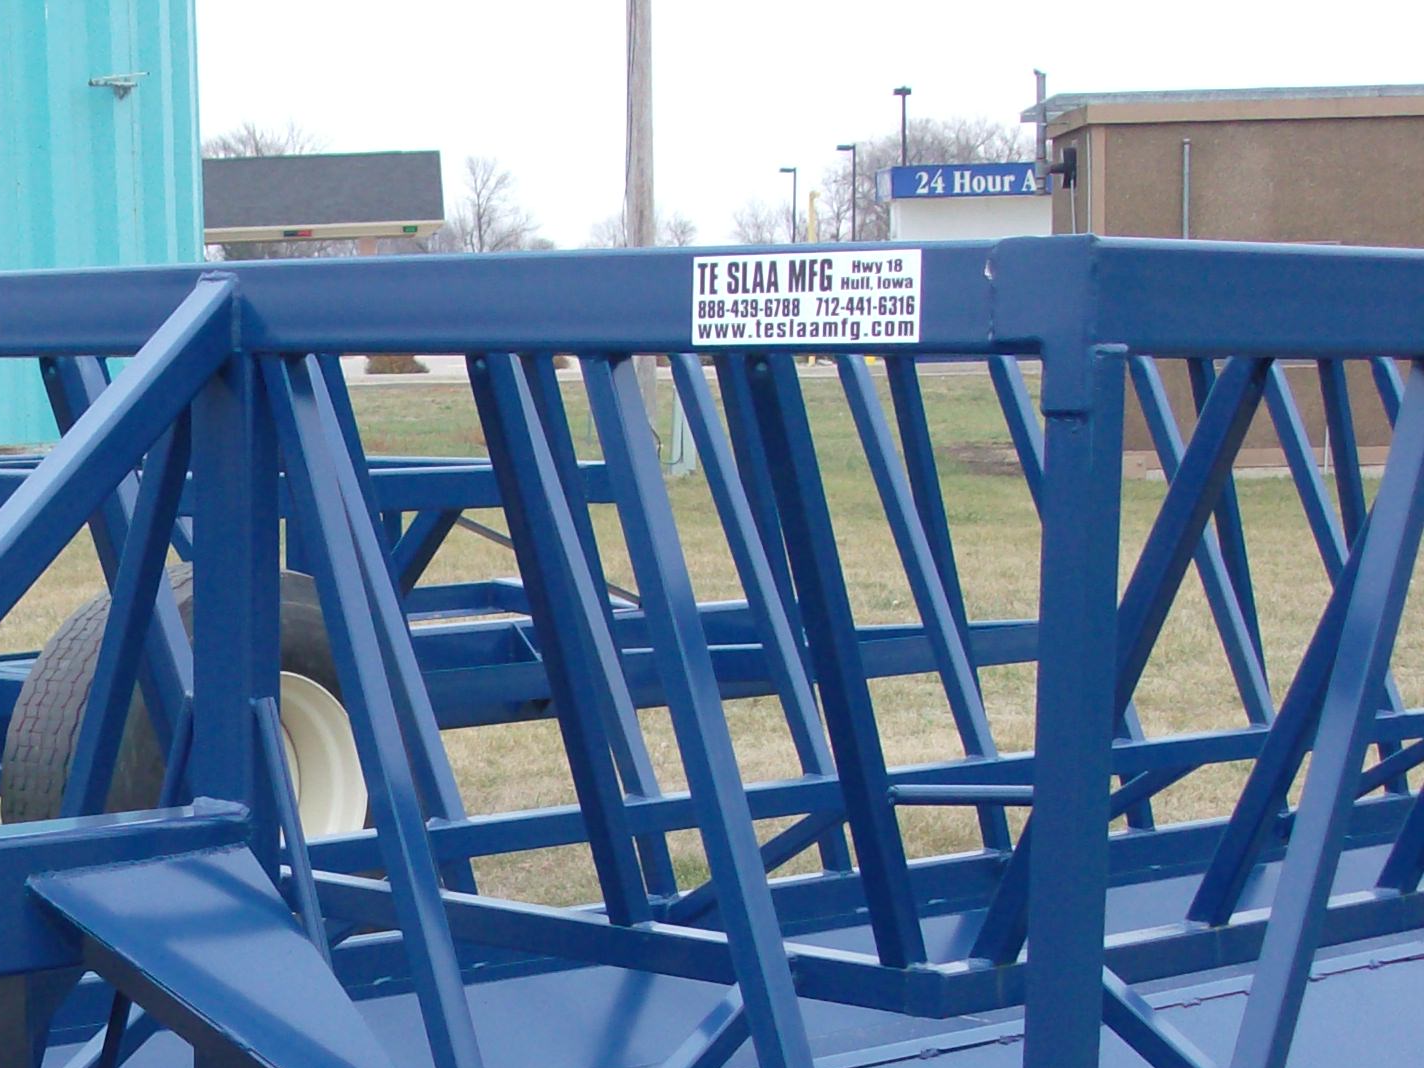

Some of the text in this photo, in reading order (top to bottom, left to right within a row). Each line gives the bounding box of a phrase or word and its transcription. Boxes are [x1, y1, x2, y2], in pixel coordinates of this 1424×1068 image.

[914, 168, 946, 194] 24
[952, 170, 1016, 194] Hour
[697, 258, 834, 296] TE SLAA MFG
[851, 258, 903, 275] Hwy 18
[840, 275, 914, 291] Hull, Iowa
[697, 295, 915, 319] 888-439-6788 712-441-6316
[697, 317, 915, 340] www.teslaamfg.com
